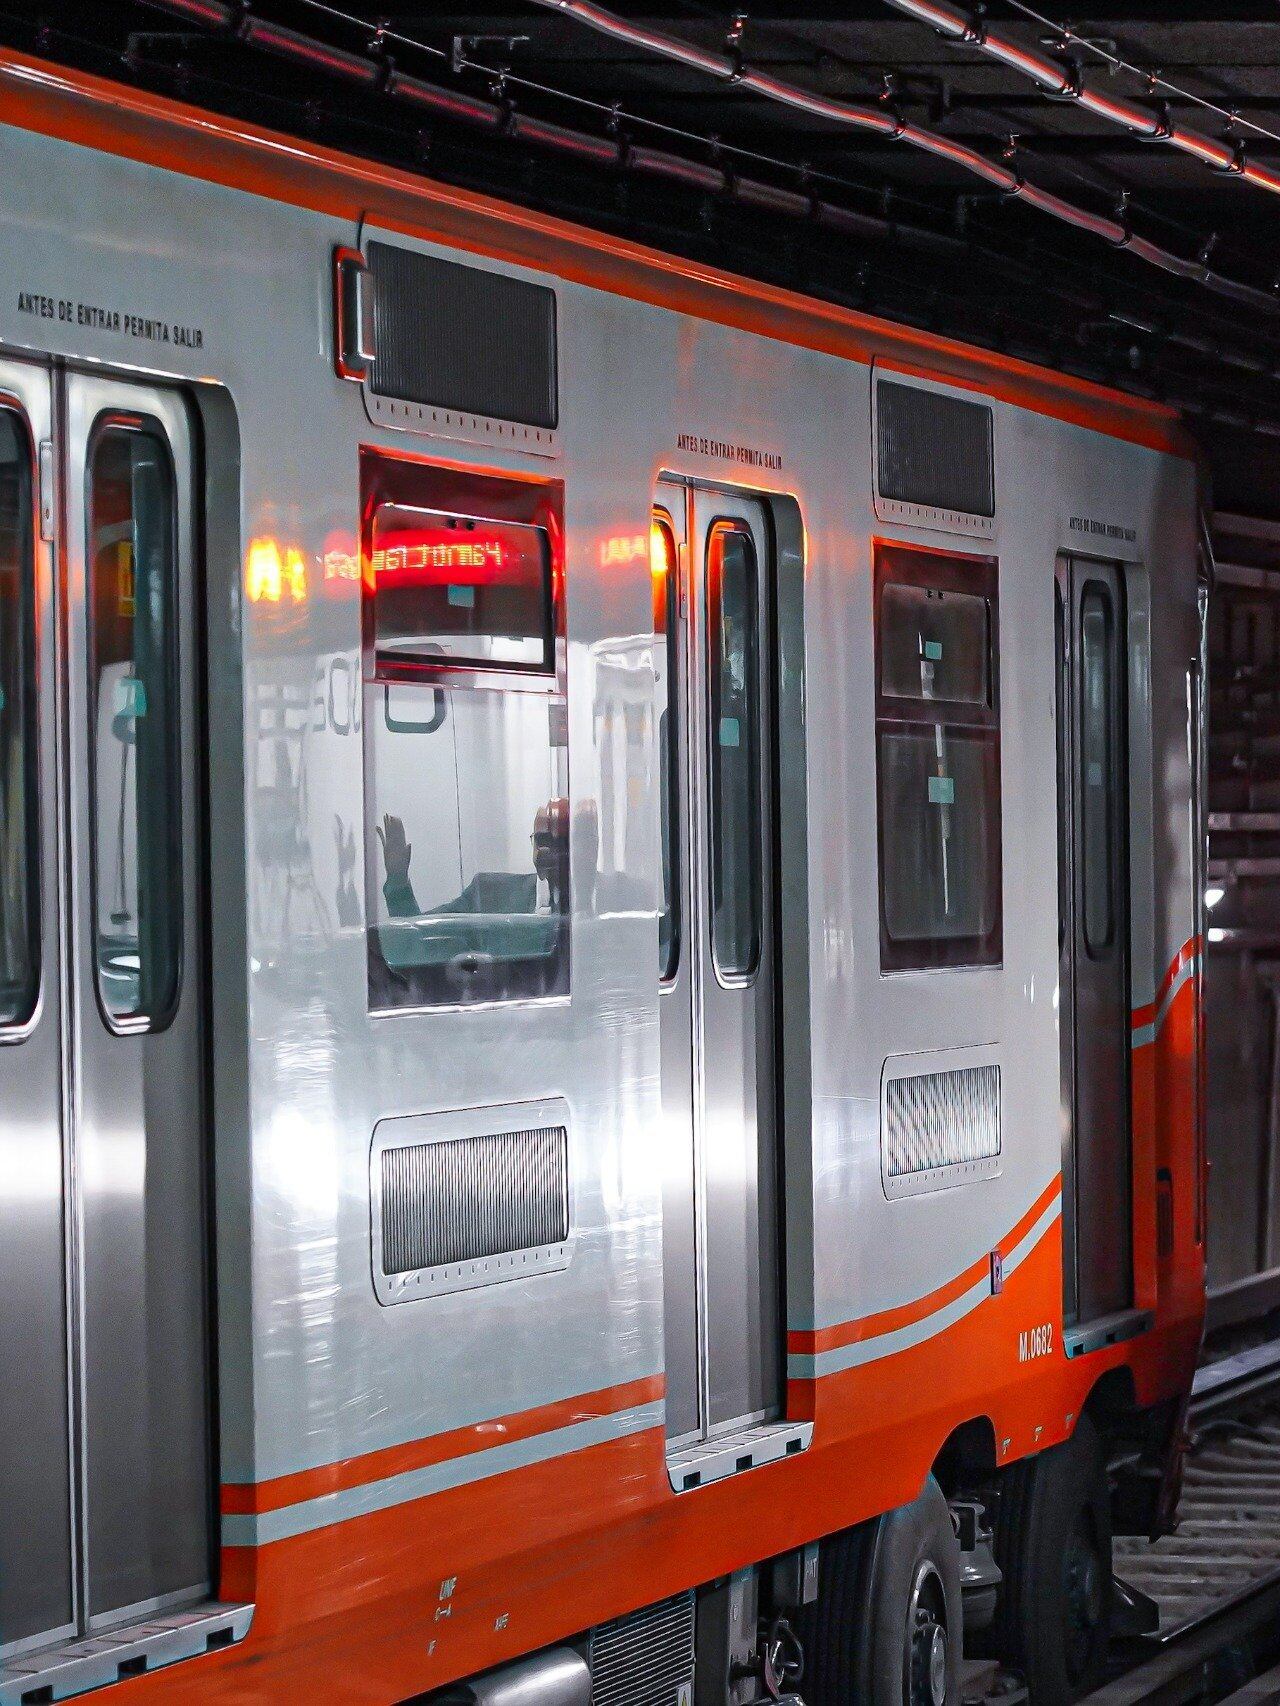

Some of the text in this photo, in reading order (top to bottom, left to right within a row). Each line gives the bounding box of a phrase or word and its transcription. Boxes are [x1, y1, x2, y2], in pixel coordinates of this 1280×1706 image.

[18, 291, 204, 349] ANTES DE ENTRAR PERMITA SALIR
[677, 434, 782, 470] ANTES DE ENTRAR PERMITA SALIR
[1019, 1322, 1053, 1362] M.0682
